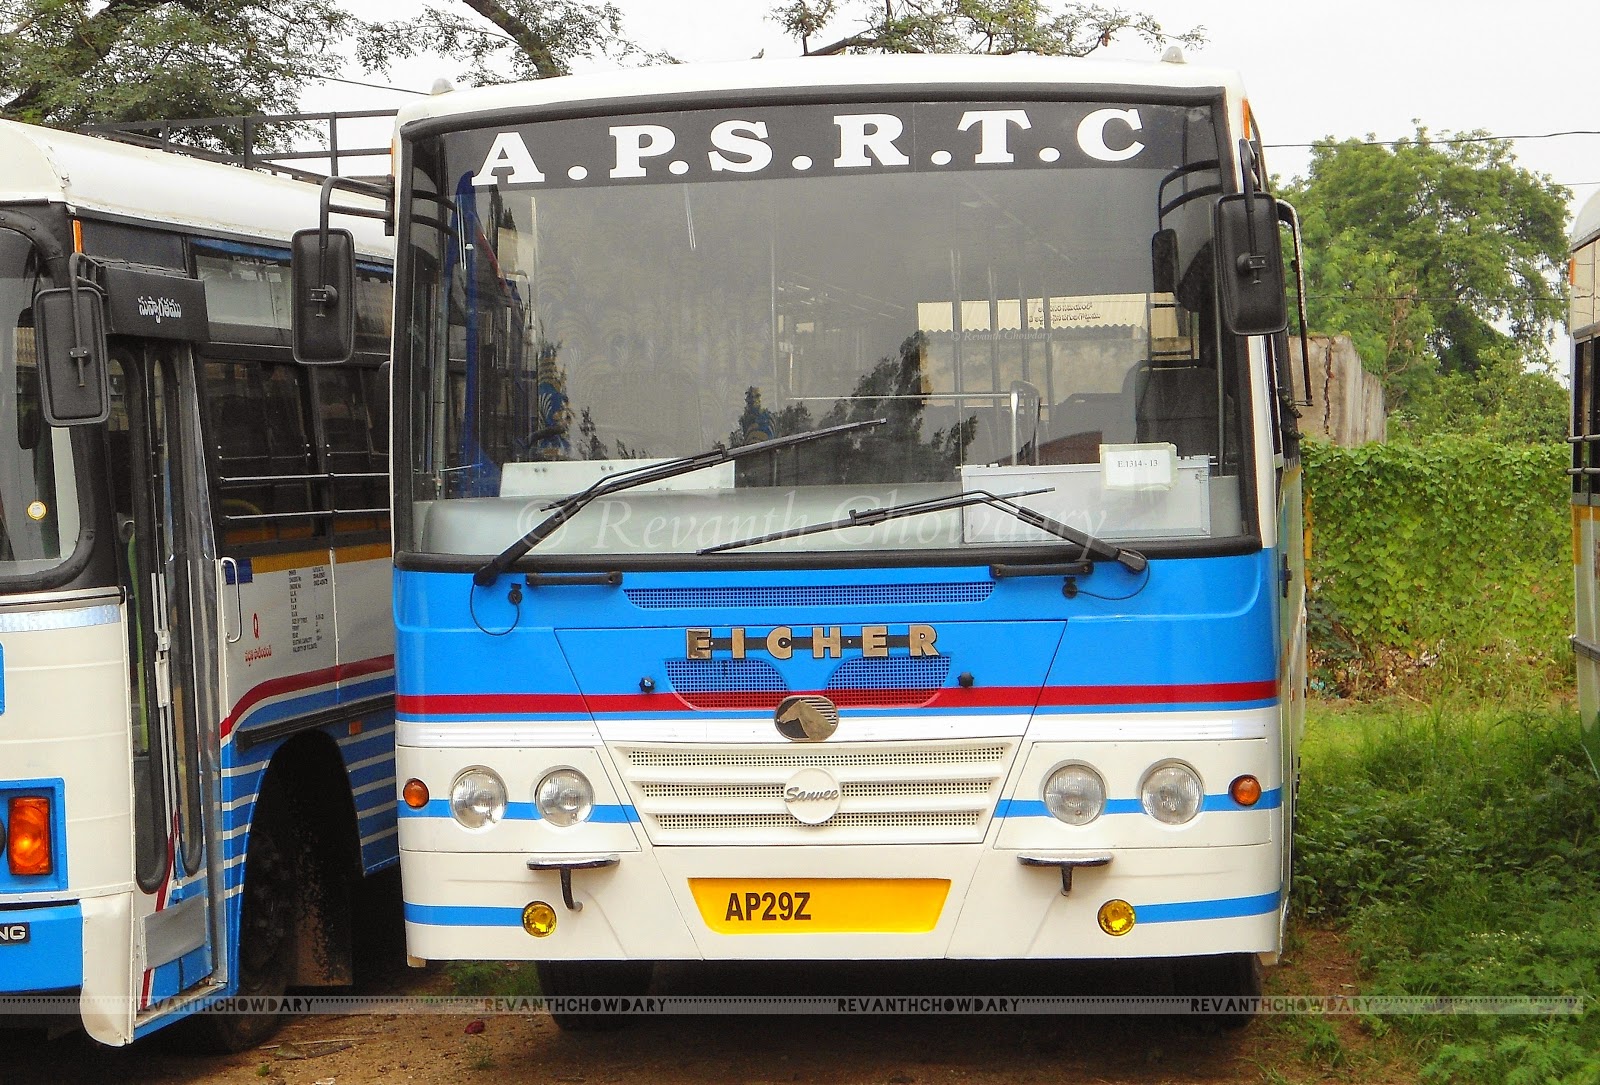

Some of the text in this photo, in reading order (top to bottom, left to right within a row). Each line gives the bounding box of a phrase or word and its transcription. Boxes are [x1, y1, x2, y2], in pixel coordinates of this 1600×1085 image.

[686, 624, 940, 660] EICHER
[783, 786, 839, 803] Sanvee
[725, 892, 812, 921] AP29Z
